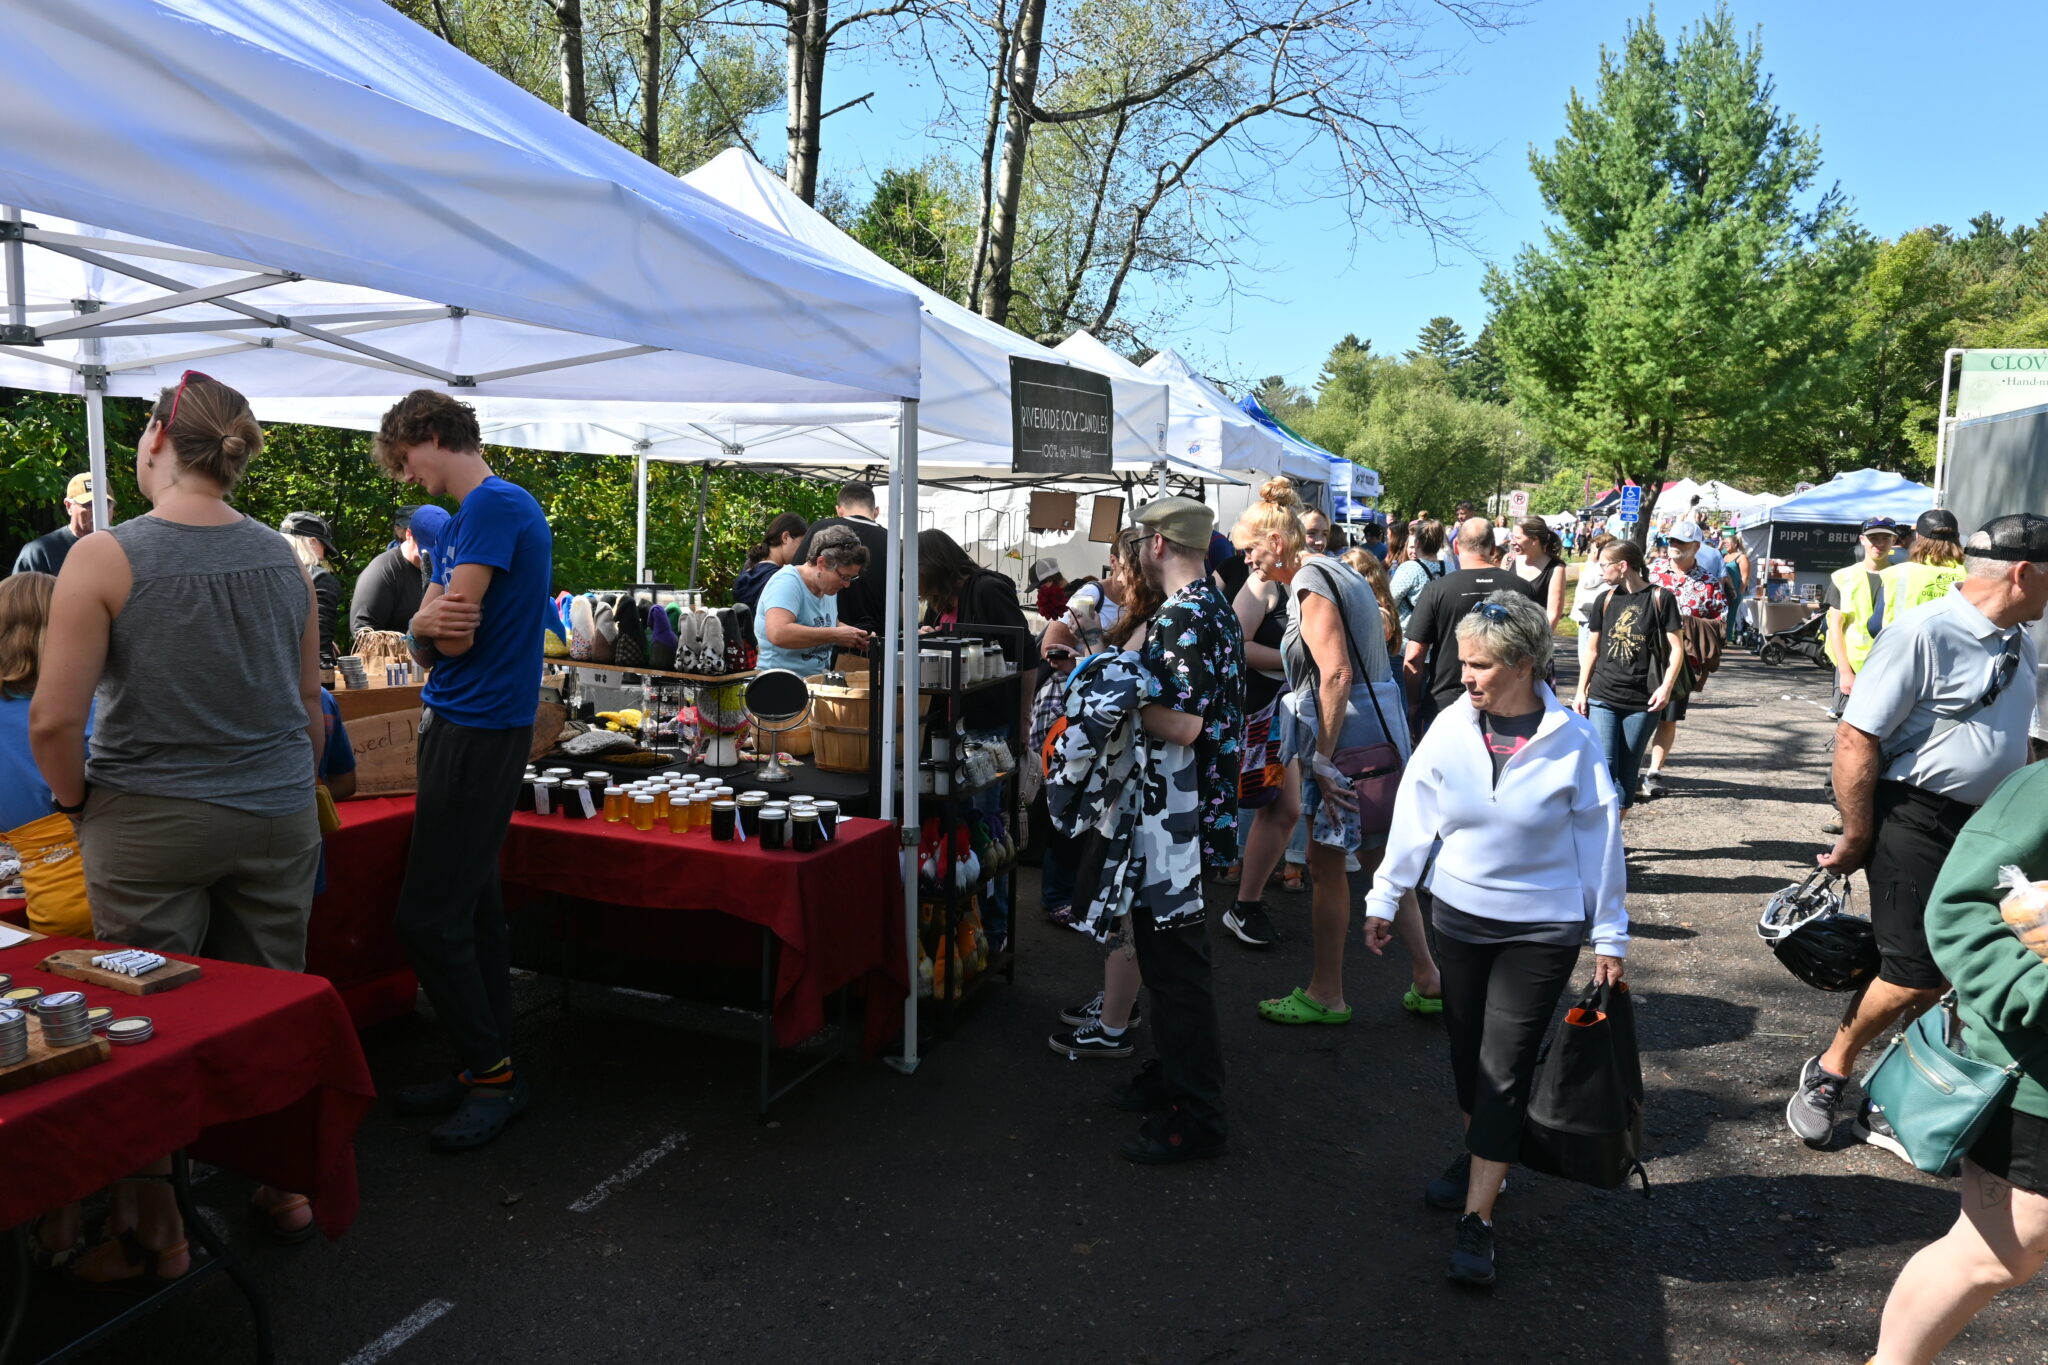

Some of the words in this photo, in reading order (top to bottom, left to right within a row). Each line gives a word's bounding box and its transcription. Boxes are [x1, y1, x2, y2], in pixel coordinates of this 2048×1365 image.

[1990, 355, 2048, 370] CLOV
[1021, 406, 1060, 430] RIVERSIDE
[1061, 410, 1078, 431] SOY
[1080, 412, 1108, 434] CANDLES
[1041, 444, 1059, 458] 100%
[1070, 445, 1080, 458] All
[1780, 531, 1808, 542] PIPPI
[1828, 532, 1858, 542] BREW
